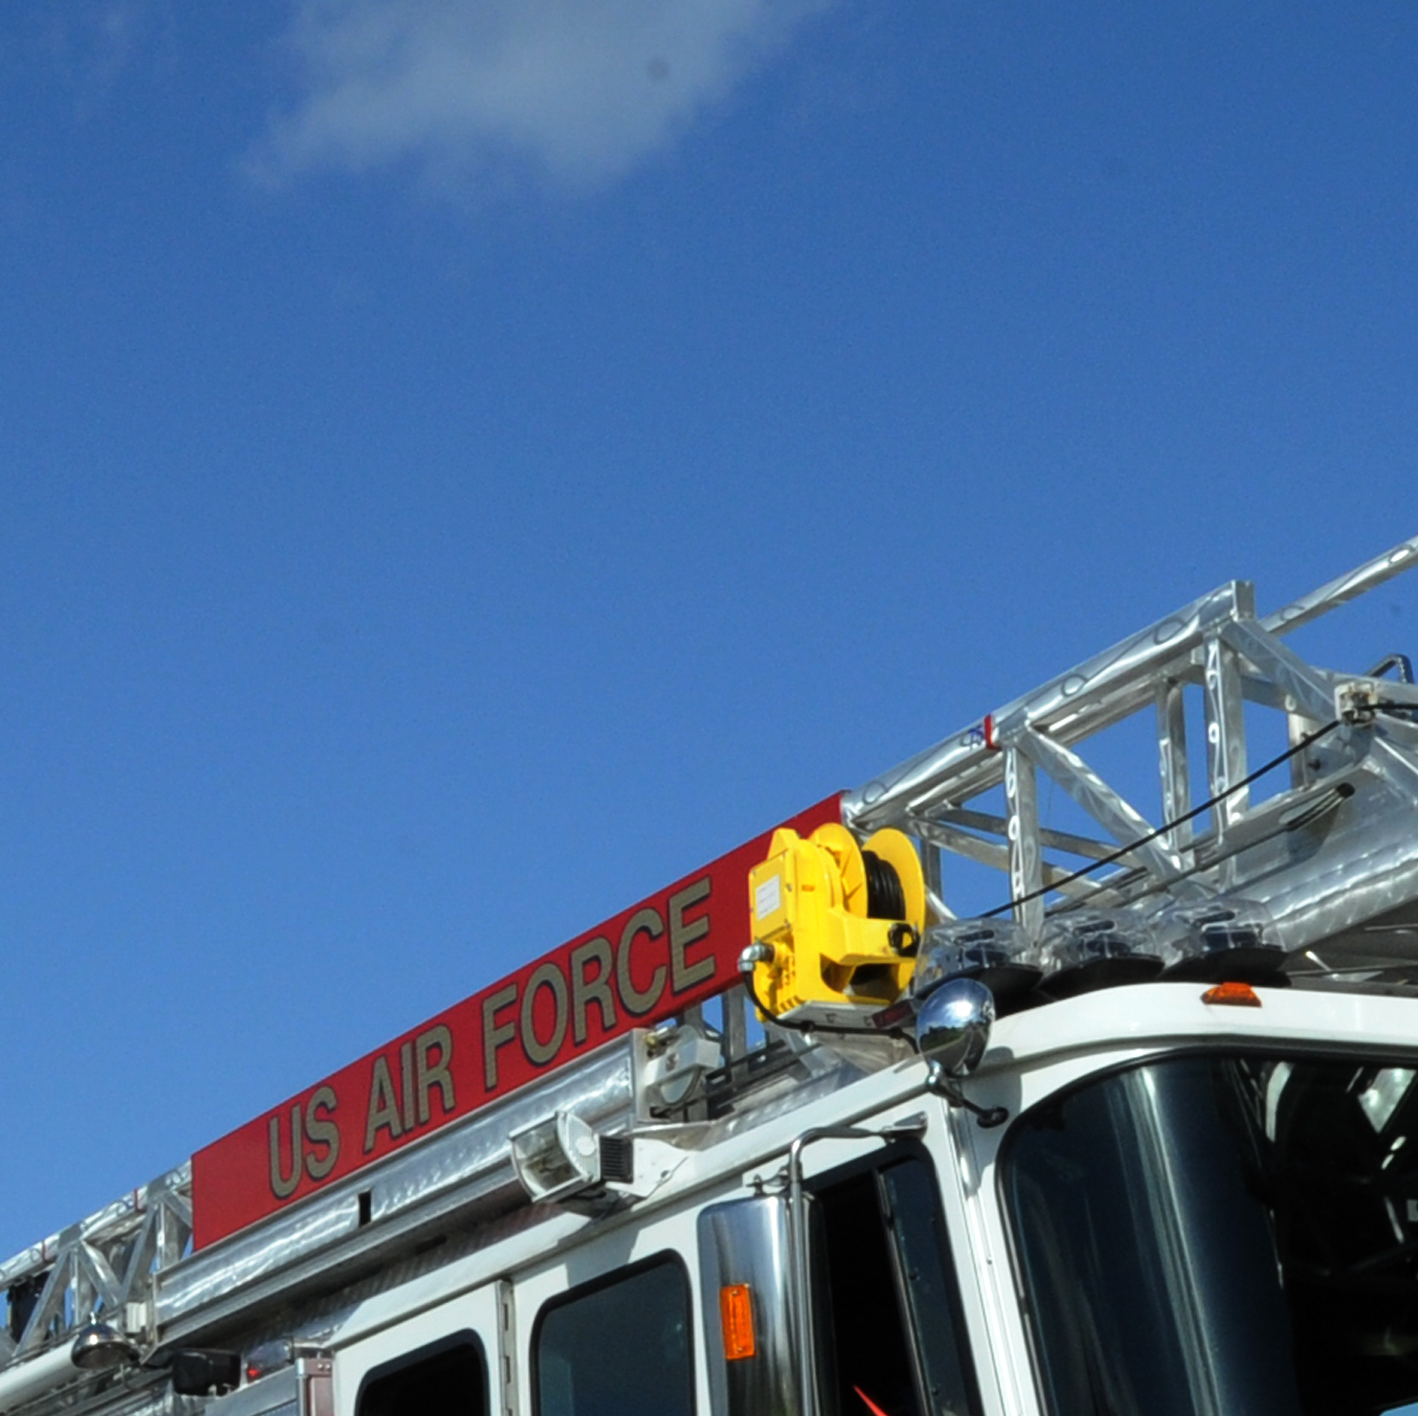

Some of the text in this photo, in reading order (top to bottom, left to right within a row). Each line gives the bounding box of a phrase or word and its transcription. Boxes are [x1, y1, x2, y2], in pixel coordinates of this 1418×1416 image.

[268, 876, 716, 1199] US AIR FORCE
